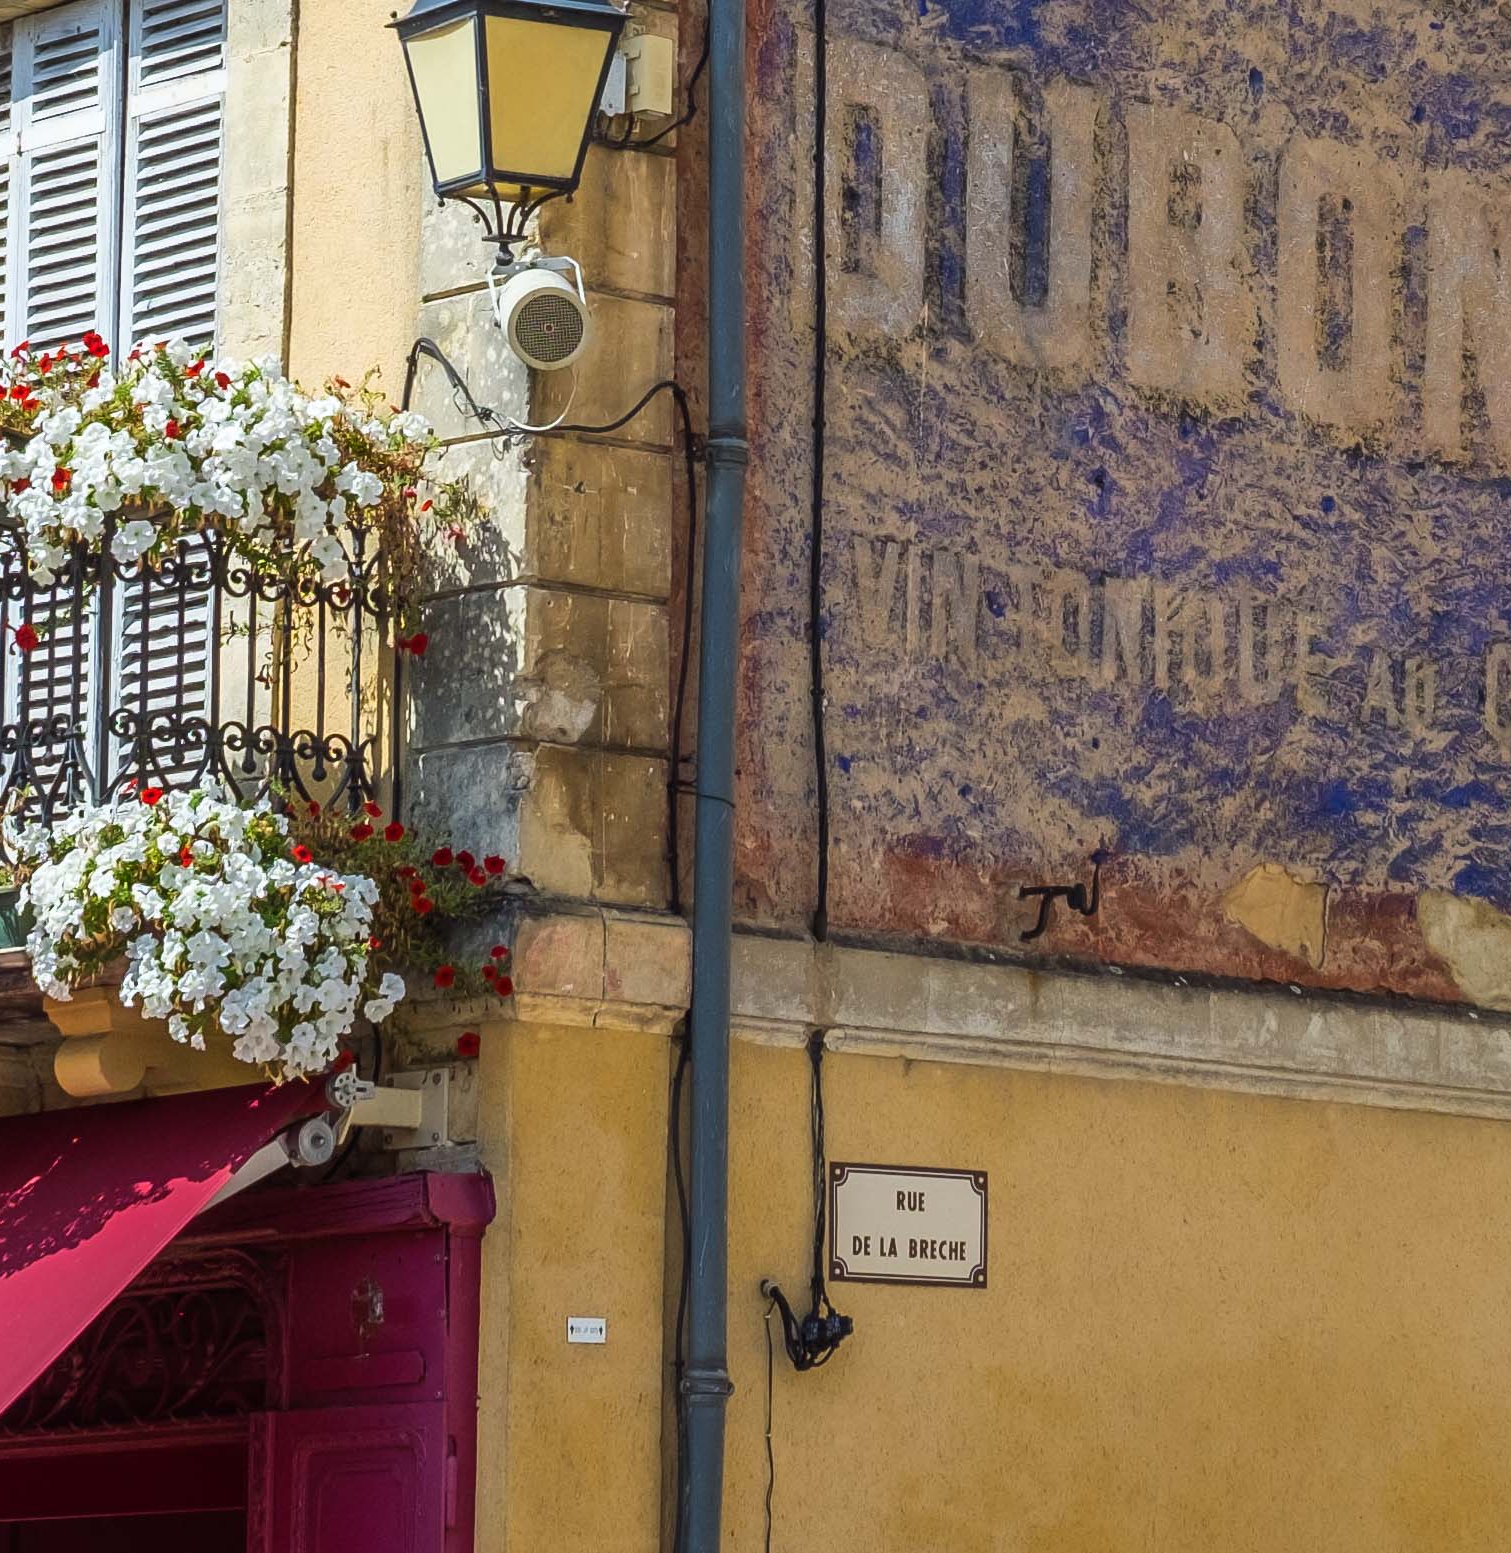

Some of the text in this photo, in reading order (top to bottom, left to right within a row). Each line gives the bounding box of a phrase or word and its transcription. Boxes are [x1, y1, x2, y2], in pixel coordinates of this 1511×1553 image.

[896, 1190, 926, 1212] RUE
[852, 1235, 966, 1261] DE LA BRECHE
